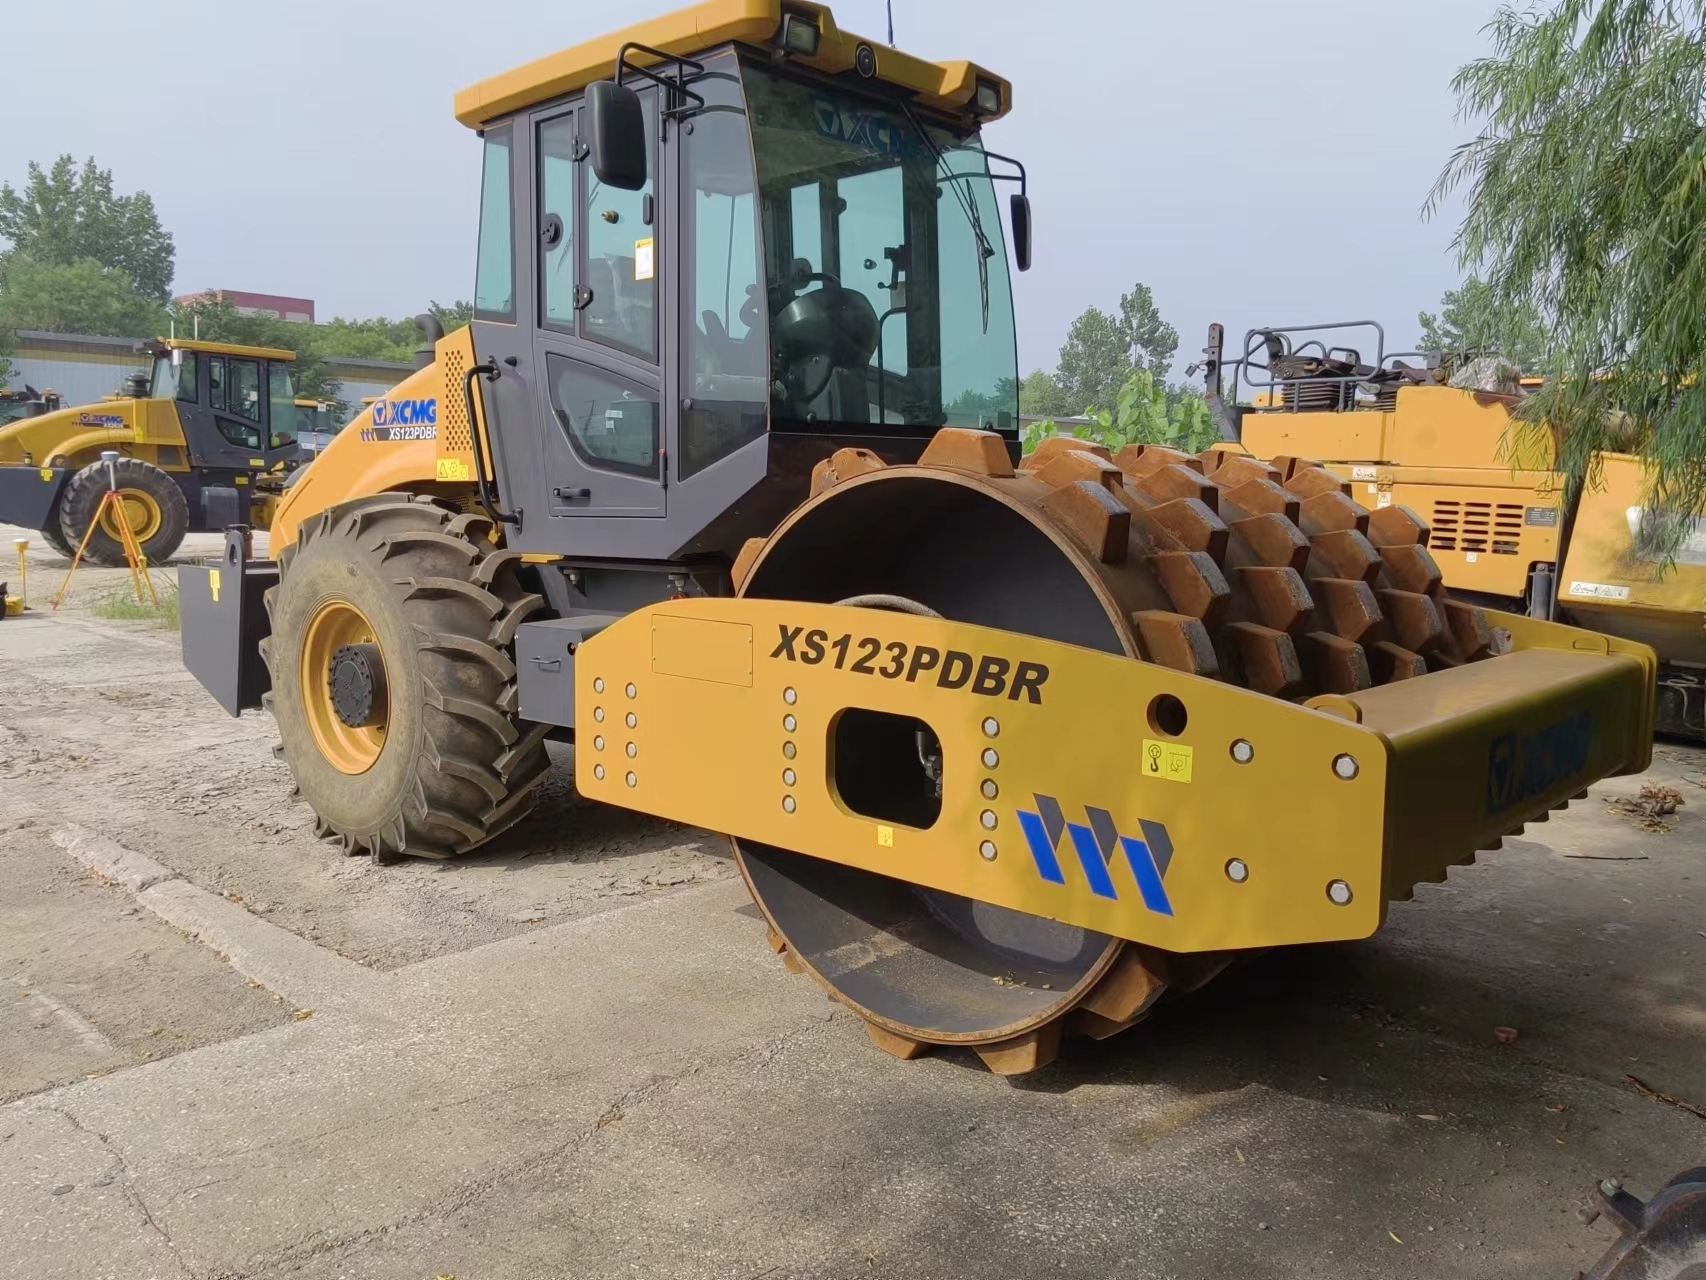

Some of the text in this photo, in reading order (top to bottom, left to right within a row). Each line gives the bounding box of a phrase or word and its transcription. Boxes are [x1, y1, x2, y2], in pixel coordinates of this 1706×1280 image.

[91, 414, 124, 425] XCMG
[388, 399, 437, 425] XCMG
[769, 624, 1050, 705] XS123PDBR
